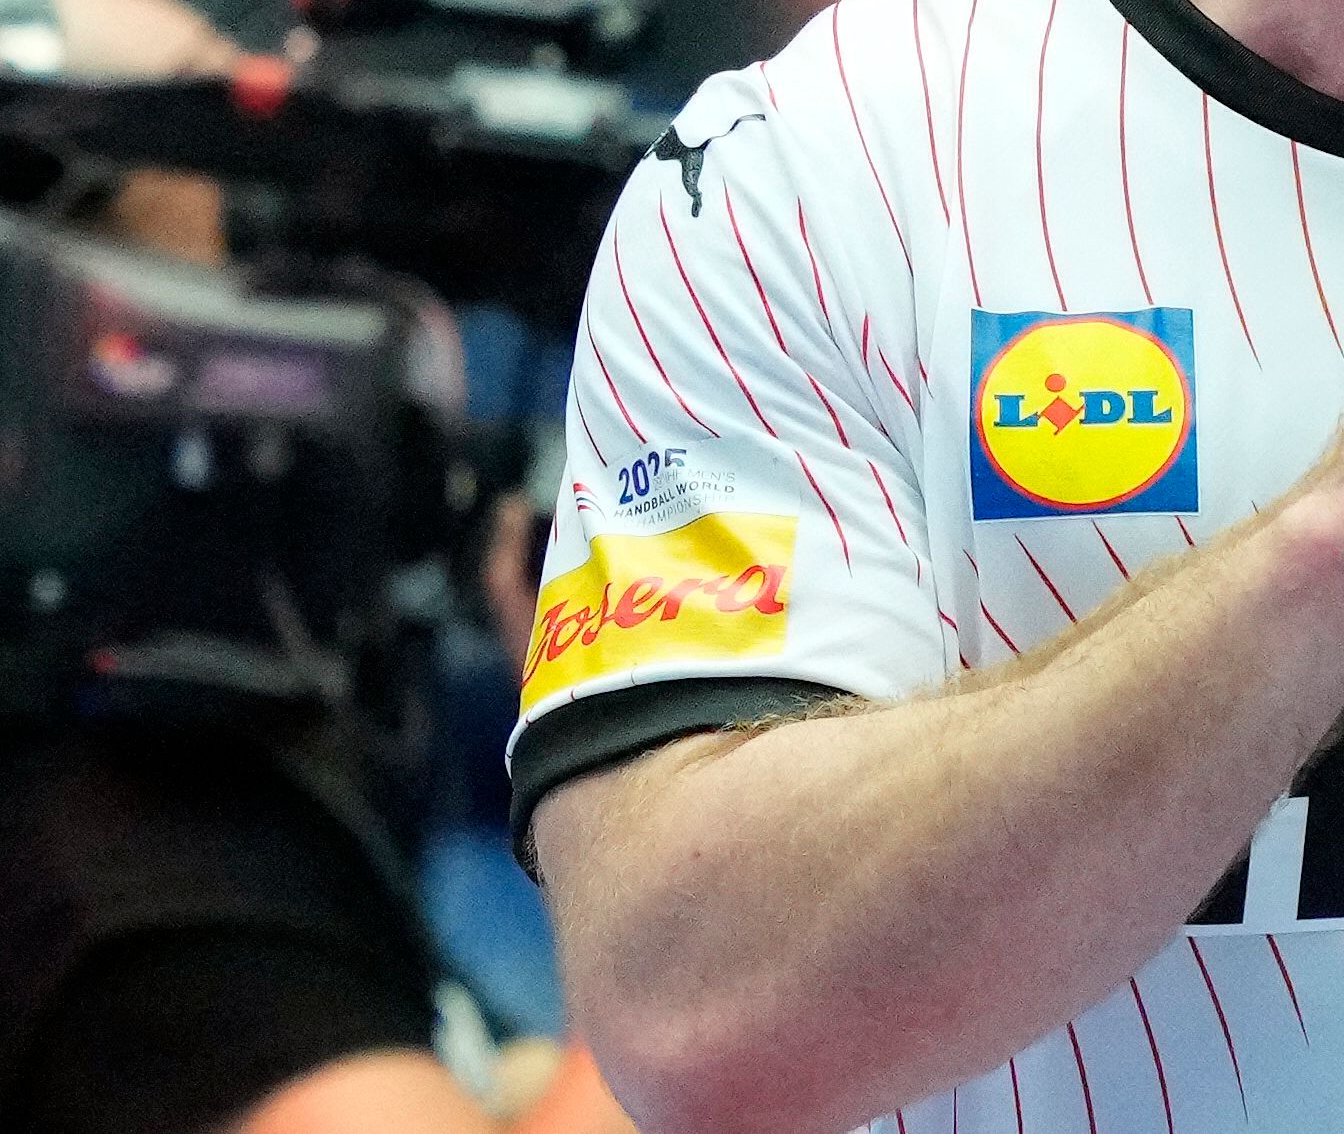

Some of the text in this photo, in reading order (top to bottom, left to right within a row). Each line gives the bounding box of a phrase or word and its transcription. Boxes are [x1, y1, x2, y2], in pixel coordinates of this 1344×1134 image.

[613, 487, 677, 518] HANDBALL
[675, 481, 735, 496] WORLD
[522, 564, 787, 689] Josera
